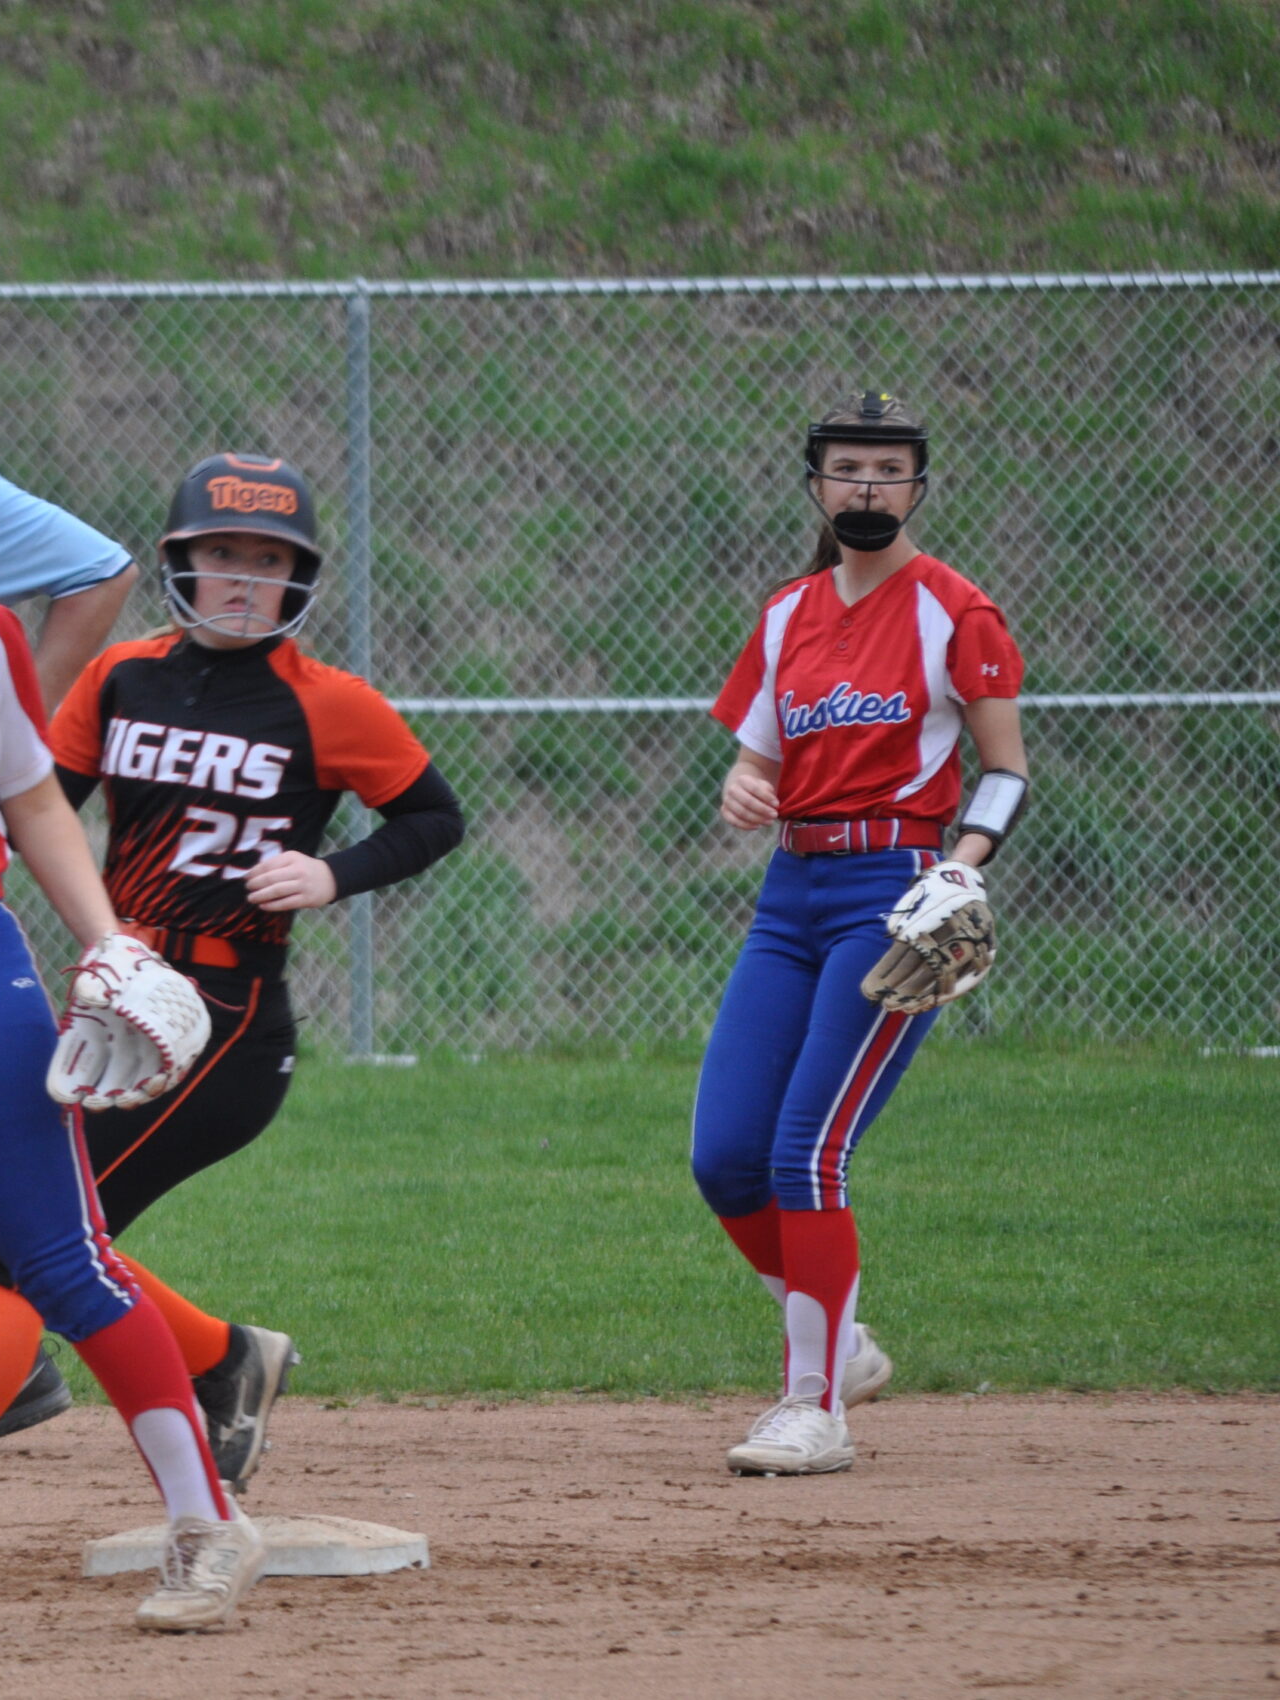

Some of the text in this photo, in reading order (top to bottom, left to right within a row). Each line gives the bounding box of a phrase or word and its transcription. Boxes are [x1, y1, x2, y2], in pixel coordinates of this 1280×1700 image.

[207, 475, 297, 516] Tigers
[780, 681, 912, 740] uskies
[101, 717, 293, 800] IGERS
[168, 805, 294, 880] 25
